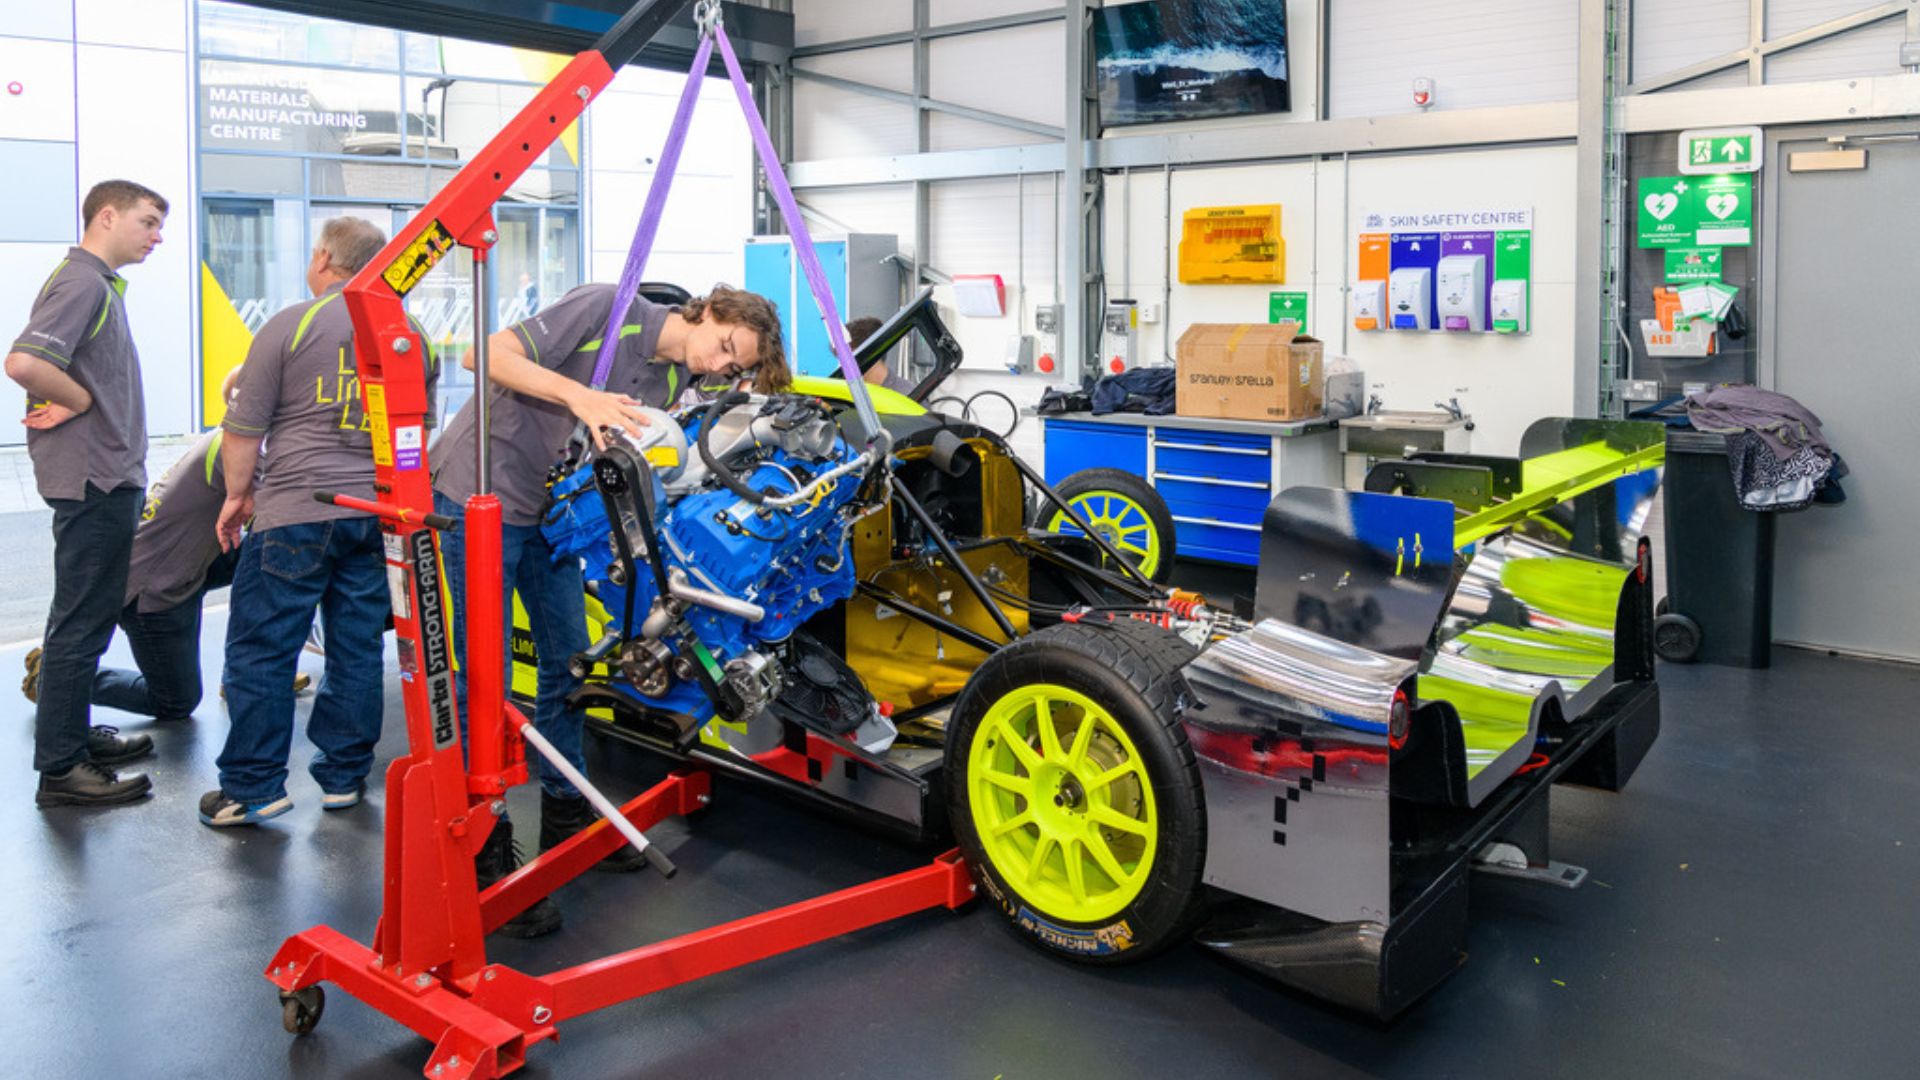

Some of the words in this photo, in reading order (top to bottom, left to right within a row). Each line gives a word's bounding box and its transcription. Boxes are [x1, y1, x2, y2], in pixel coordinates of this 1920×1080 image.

[209, 87, 310, 108] MATERIALS
[209, 105, 367, 129] MANUFACTURING
[210, 124, 282, 141] CENTRE
[1390, 215, 1419, 227] SKIN
[1423, 213, 1469, 226] SAFETY
[1472, 211, 1525, 225] CENTRE
[1656, 224, 1675, 232] AED
[1651, 334, 1672, 345] AED
[432, 677, 453, 745] Clarke
